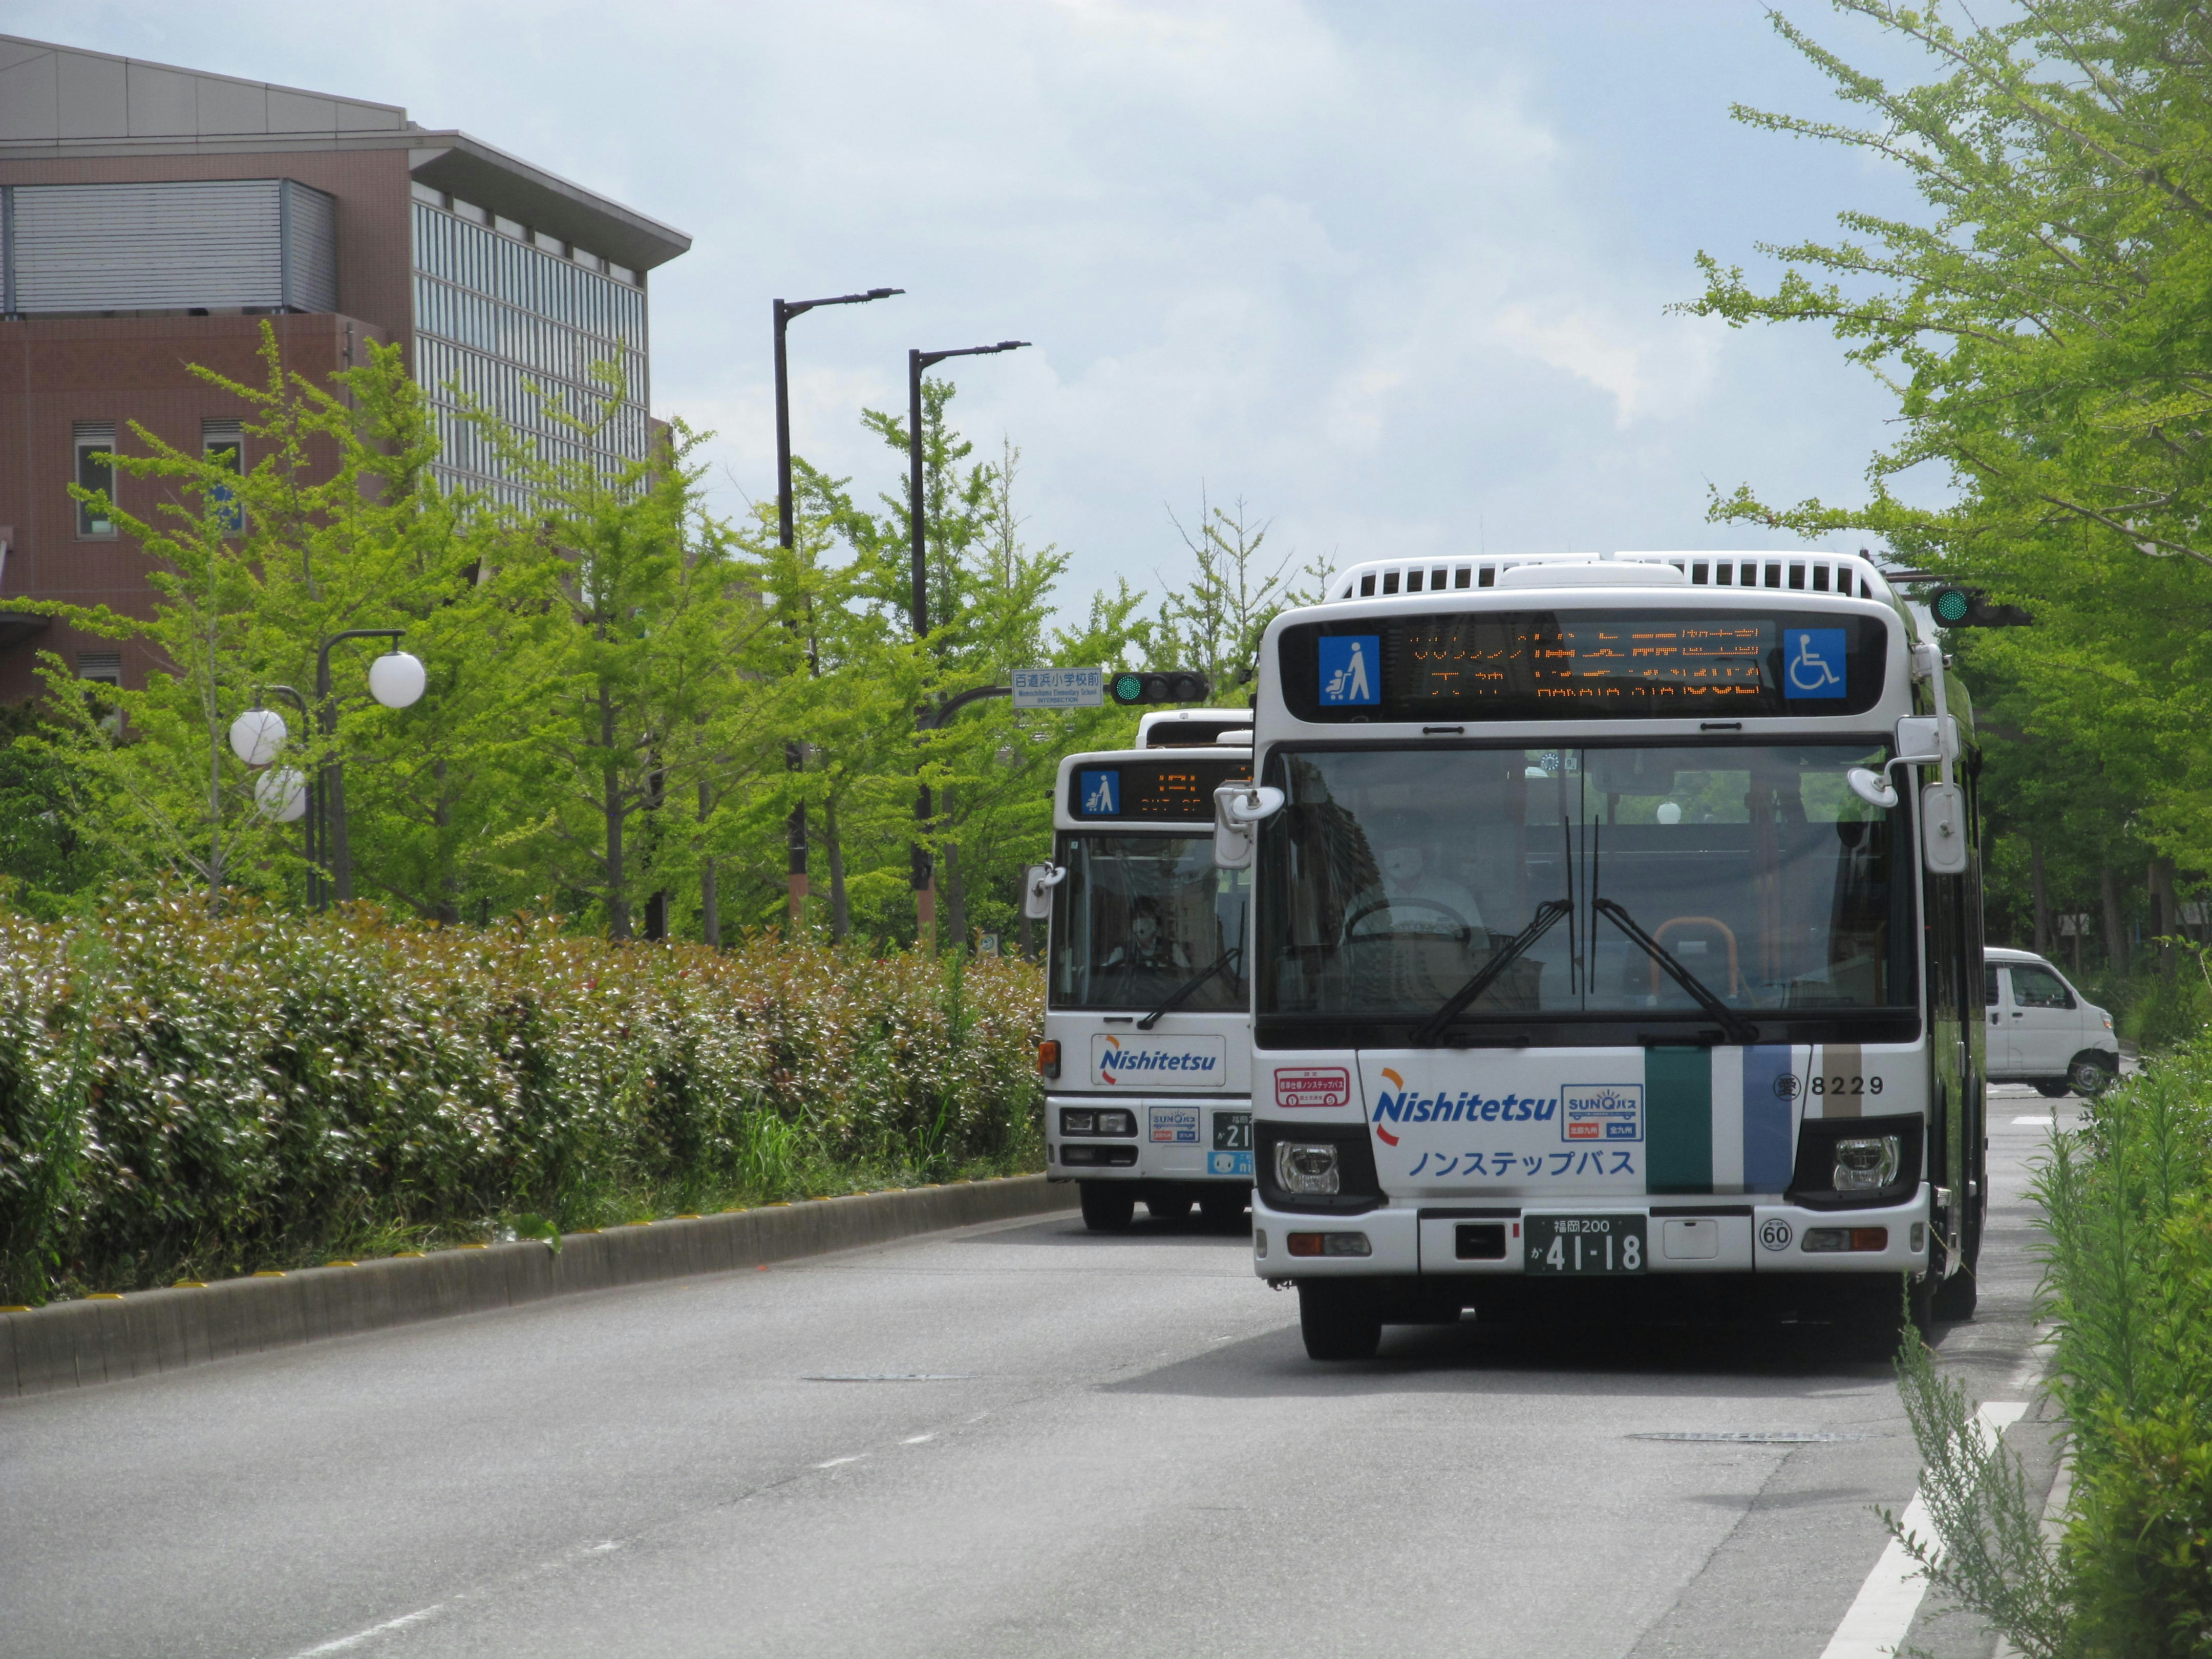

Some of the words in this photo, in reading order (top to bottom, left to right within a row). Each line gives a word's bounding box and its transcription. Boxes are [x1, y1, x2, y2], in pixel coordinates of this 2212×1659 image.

[1015, 672, 1099, 687] 百道浜小学校前
[1053, 689, 1079, 697] Elementary
[1100, 1050, 1217, 1071] Nishitetsu
[1812, 1076, 1884, 1096] 8229
[1372, 1091, 1557, 1123] Nishitetsu
[1409, 1151, 1635, 1177] ノンステップバス
[1554, 1220, 1610, 1234] 福岡200
[1763, 1226, 1789, 1243] 60
[1530, 1247, 1543, 1259] か
